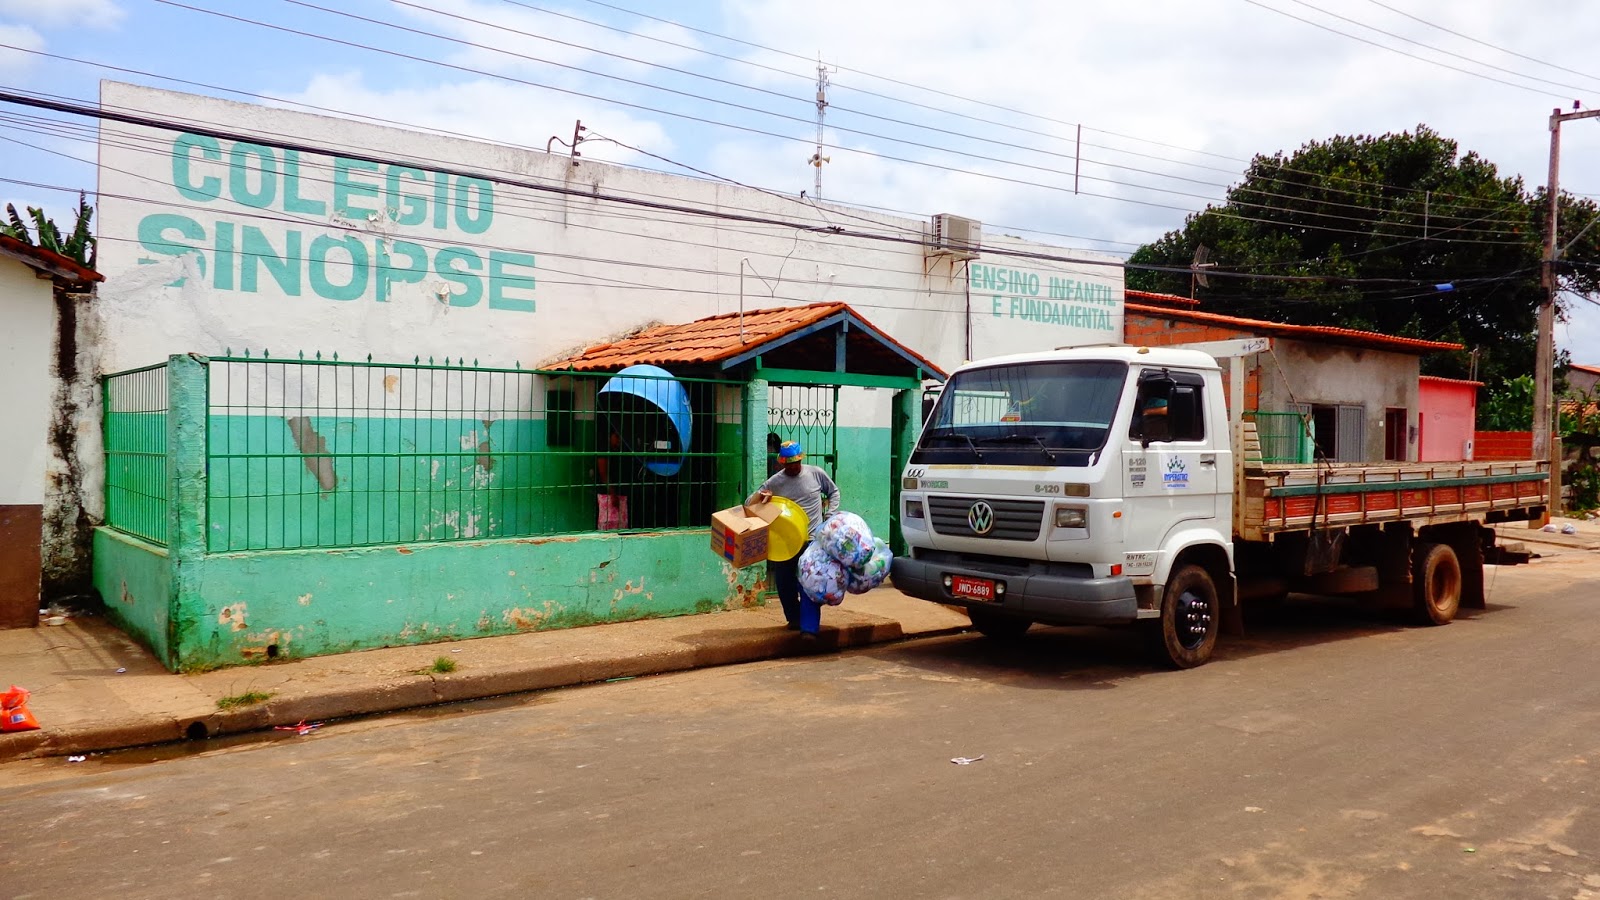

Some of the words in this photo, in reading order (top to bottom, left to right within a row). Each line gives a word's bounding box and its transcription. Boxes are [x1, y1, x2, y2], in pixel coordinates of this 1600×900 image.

[172, 132, 494, 235] COLEGIO
[138, 213, 536, 313] SINOPSE
[971, 263, 1040, 297] ENSINO
[1049, 276, 1117, 307] INFANTIL
[992, 294, 1002, 318] E
[1009, 296, 1115, 331] FUNDAMENTAL
[920, 480, 949, 489] WORKER
[1034, 484, 1060, 494] 8-120
